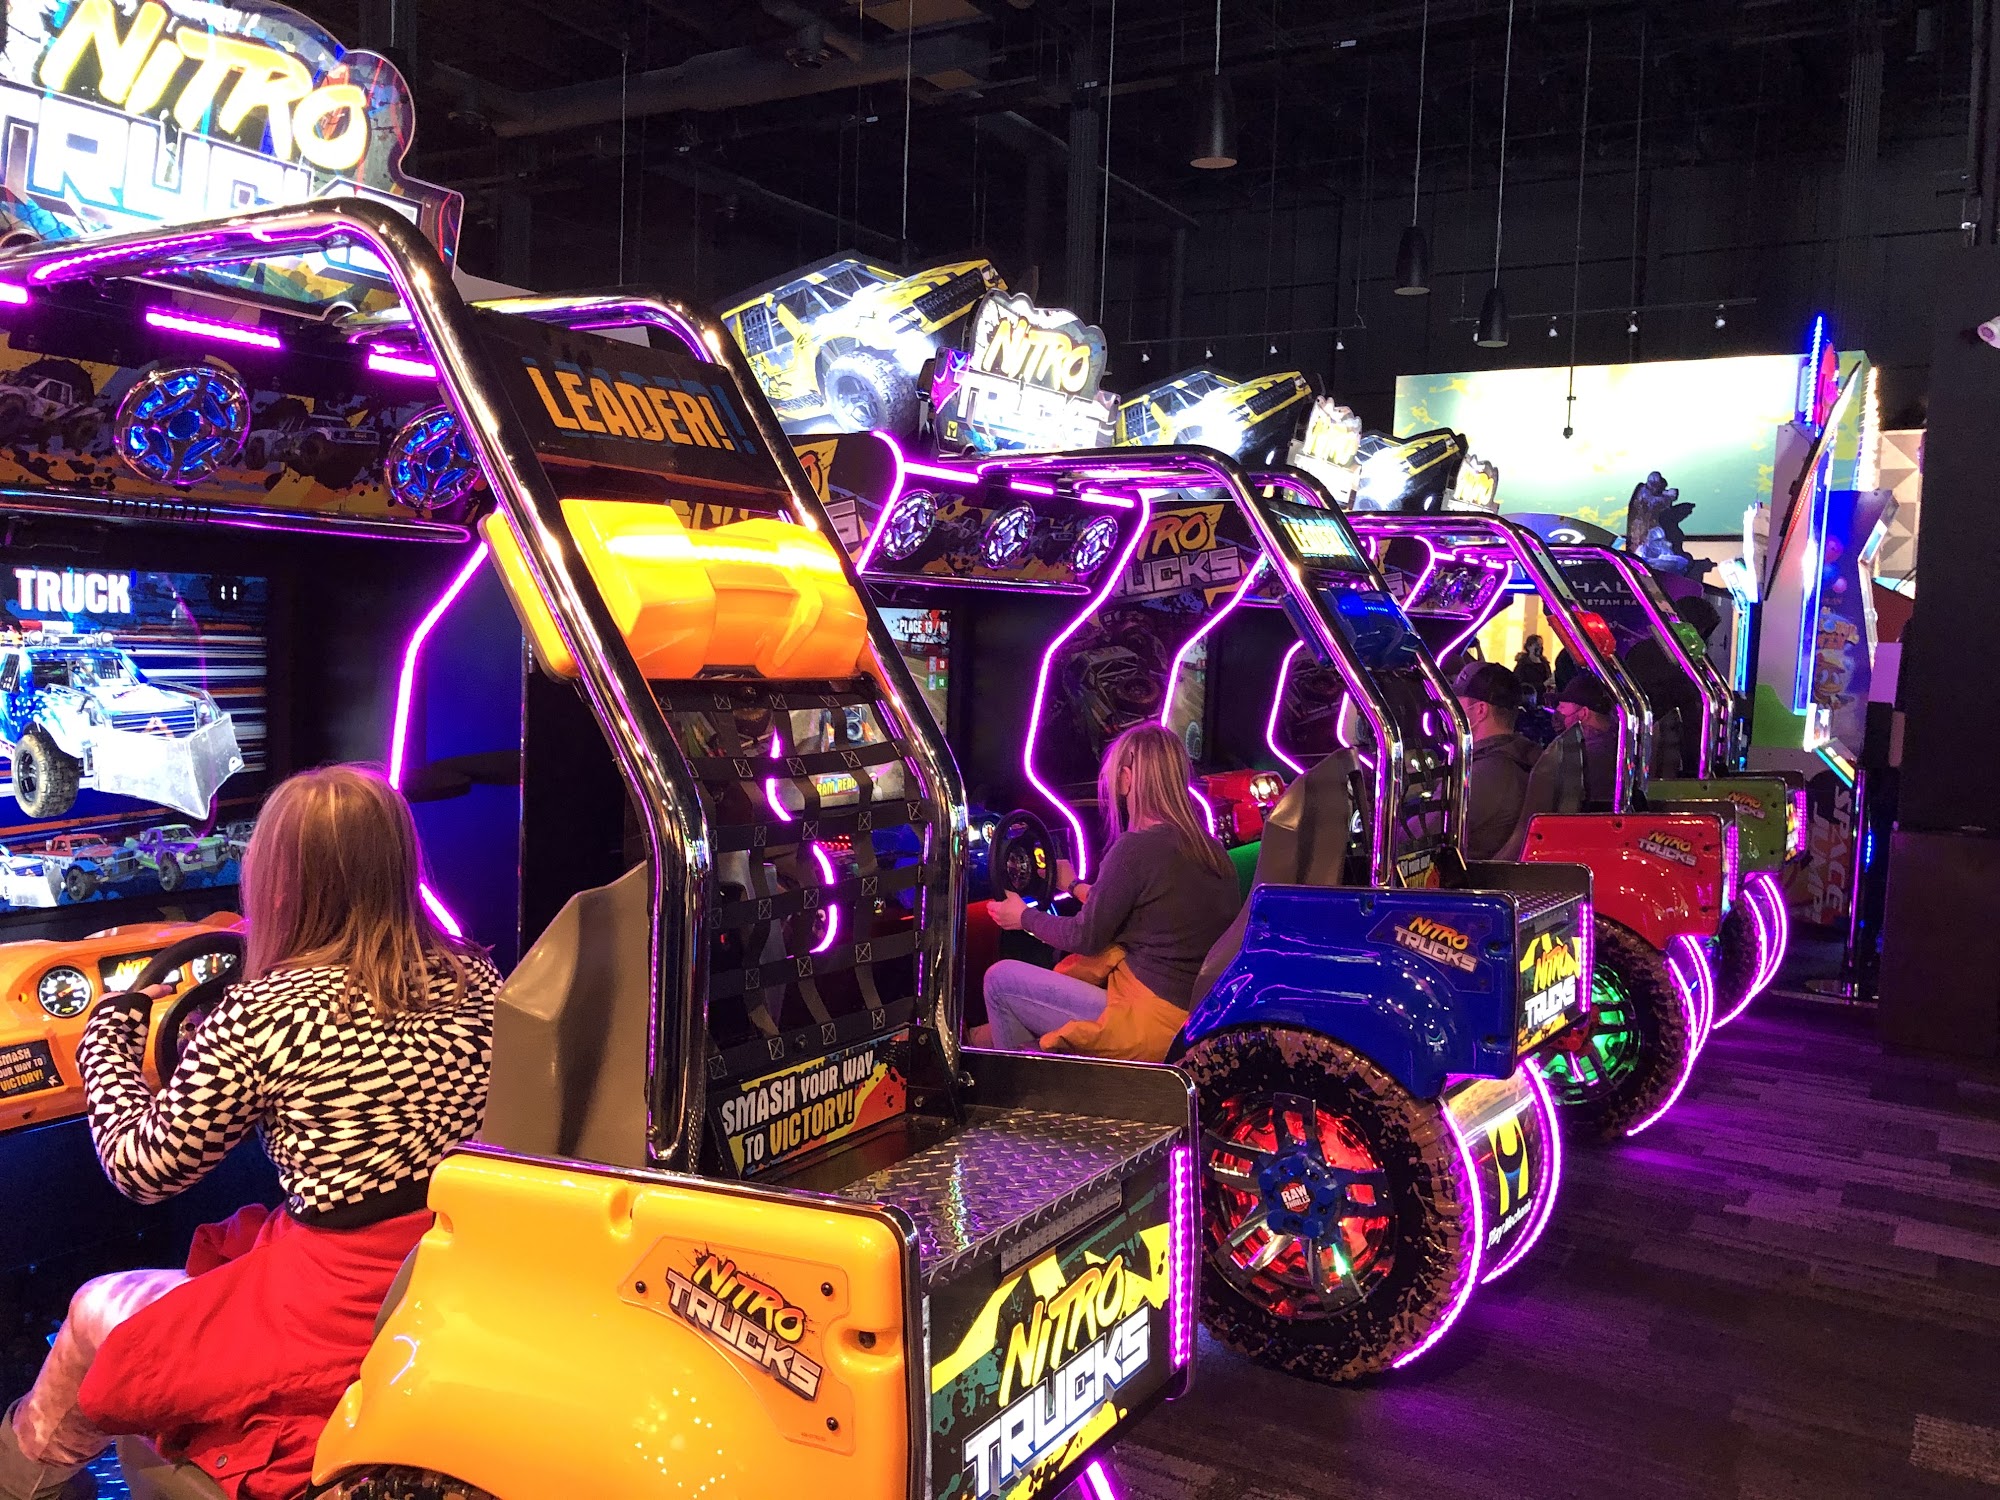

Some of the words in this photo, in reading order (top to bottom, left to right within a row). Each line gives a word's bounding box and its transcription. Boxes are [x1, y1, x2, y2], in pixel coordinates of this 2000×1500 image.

[525, 365, 735, 451] LEADER!
[14, 567, 131, 614] TRUCK
[1571, 581, 1632, 593] HAL
[1638, 838, 1697, 867] TRUCKS
[1394, 925, 1477, 973] TRUCKS
[1524, 975, 1576, 1029] TRUCKS
[0, 1068, 45, 1092] VICTORY!
[14, 1060, 31, 1073] WAY
[34, 1057, 44, 1068] TO
[721, 1075, 796, 1136] SMASH
[800, 1065, 839, 1103] YOUR
[842, 1049, 874, 1085] WAY
[744, 1132, 765, 1164] TO
[769, 1088, 854, 1156] VICTORY!
[1280, 1184, 1308, 1203] RAW
[666, 1268, 824, 1400] TRUCKS
[962, 1303, 1150, 1500] TRUCKS
